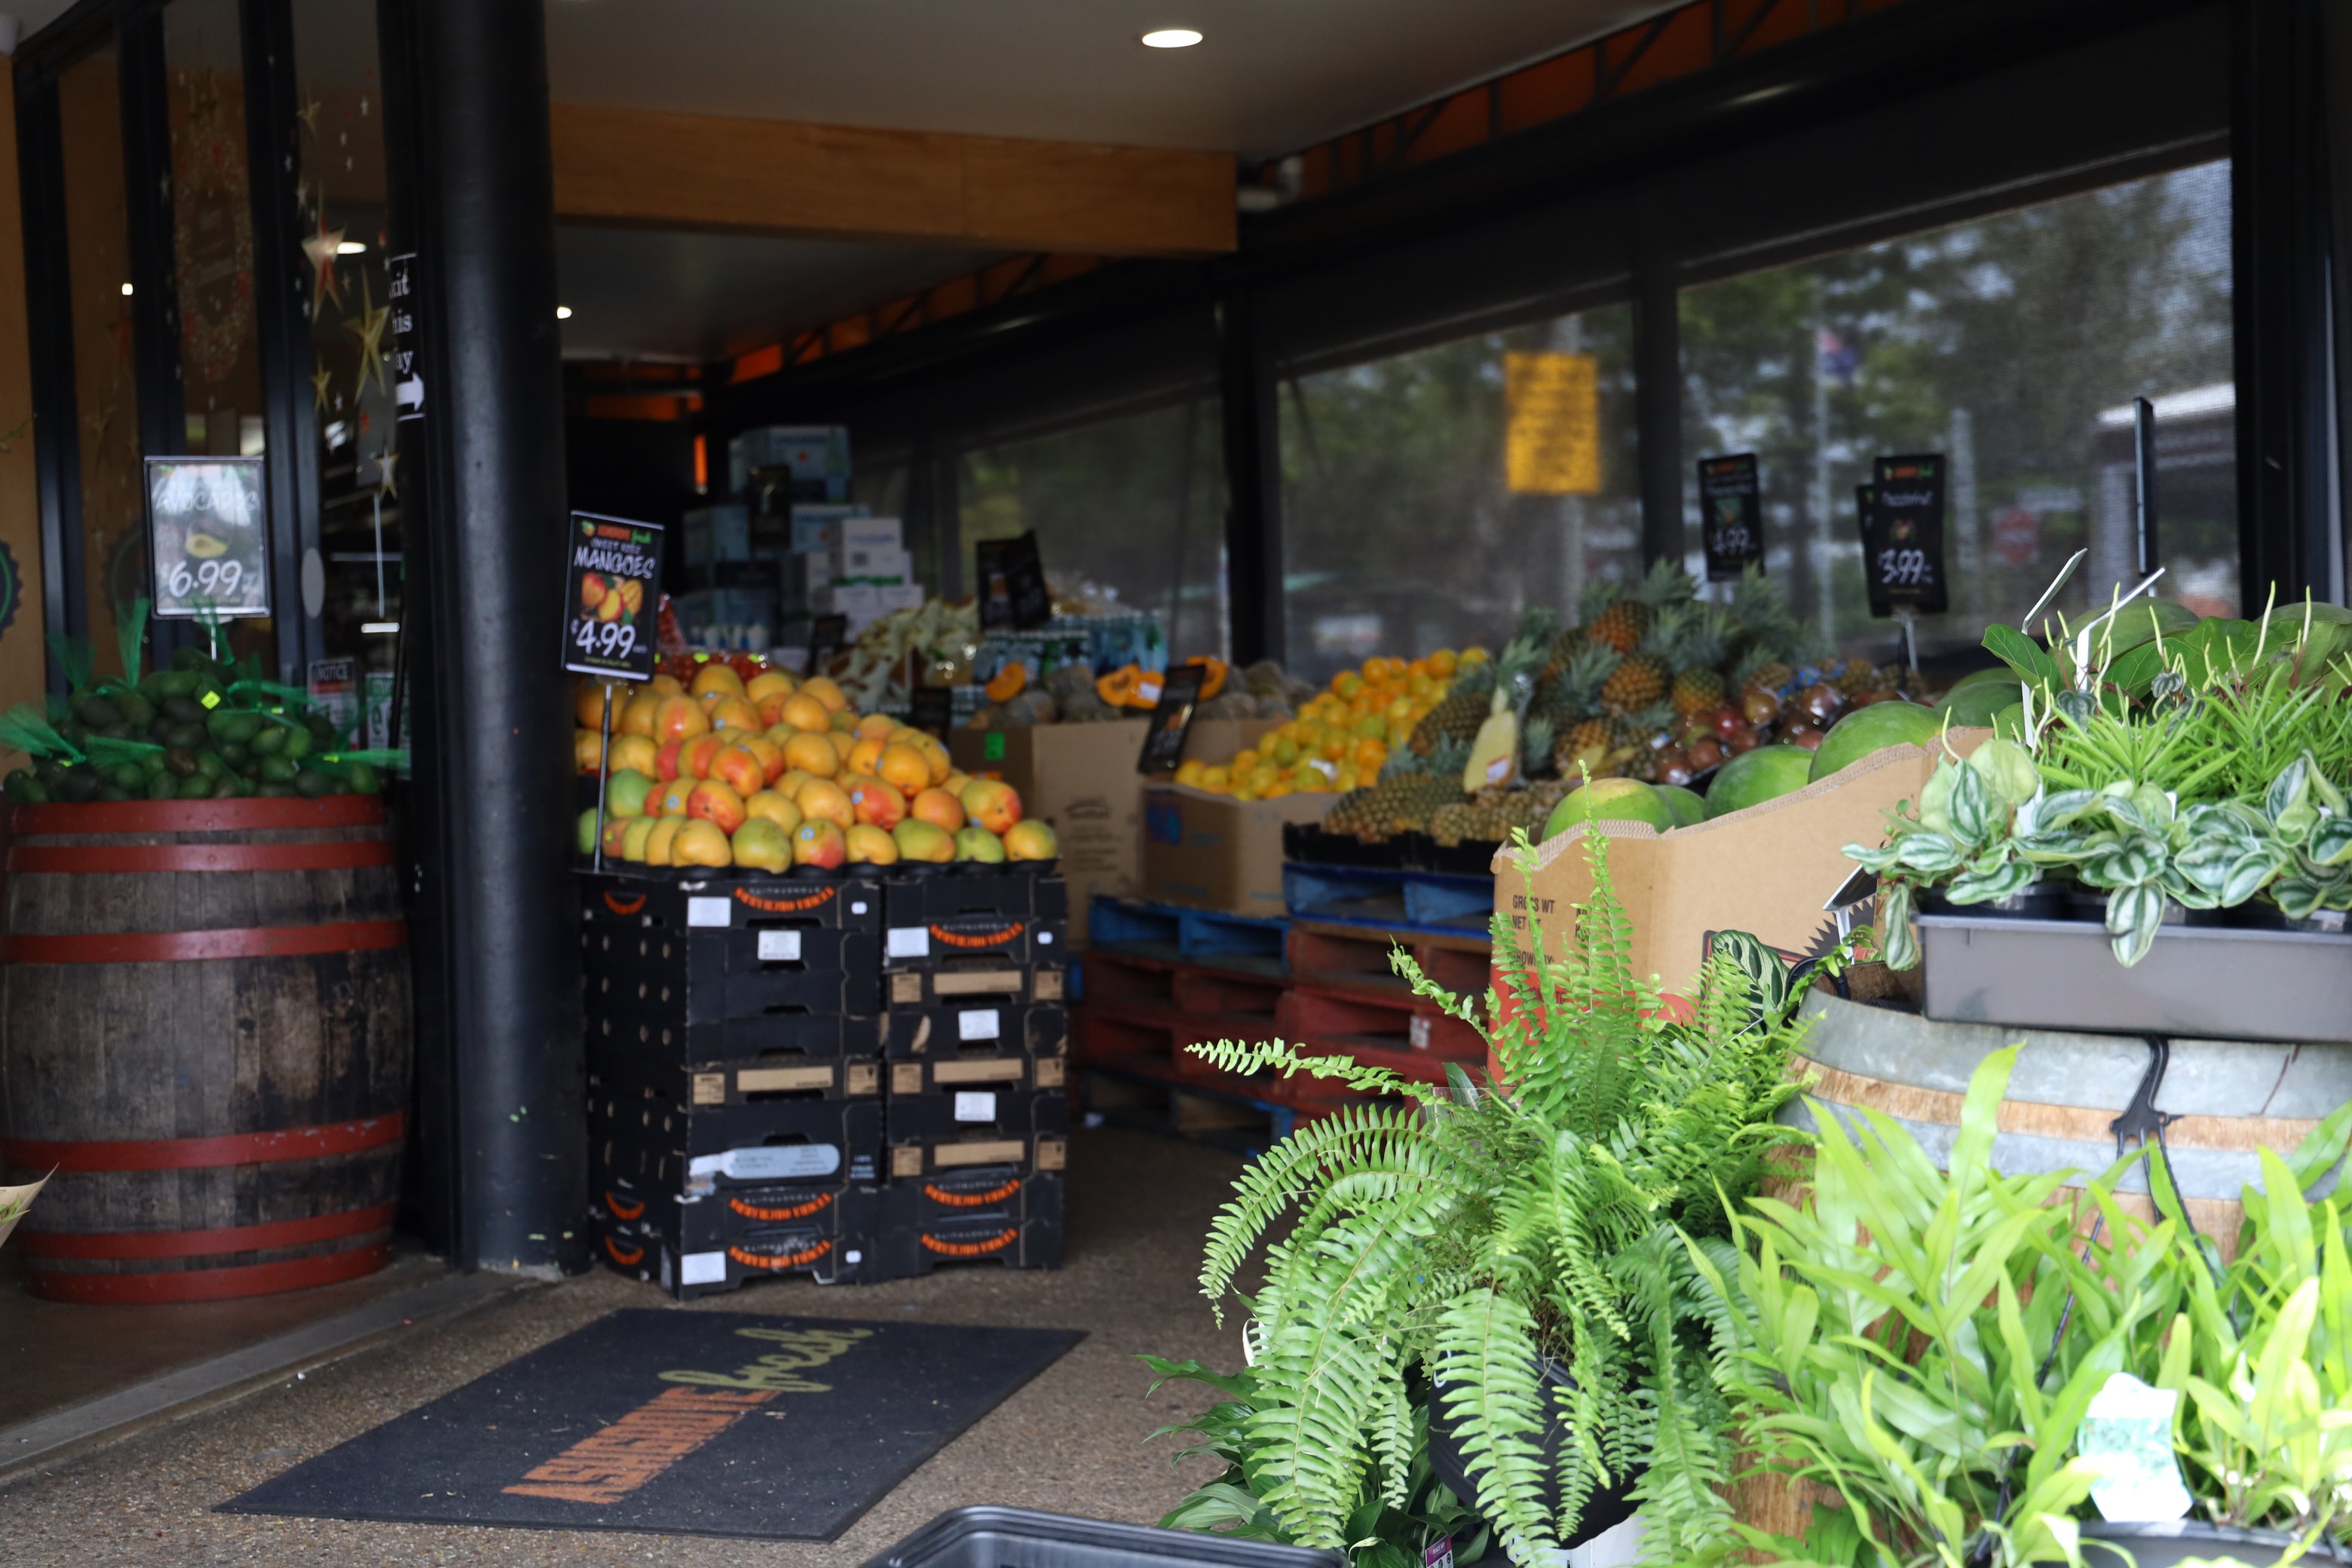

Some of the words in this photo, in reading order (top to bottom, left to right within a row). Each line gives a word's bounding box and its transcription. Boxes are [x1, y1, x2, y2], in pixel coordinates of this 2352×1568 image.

[574, 544, 656, 579] MANGOES
[1541, 899, 1555, 914] WT
[1512, 914, 1527, 930] NET
[501, 1386, 784, 1505] ASHGROVE
[657, 1328, 874, 1392] fresh
